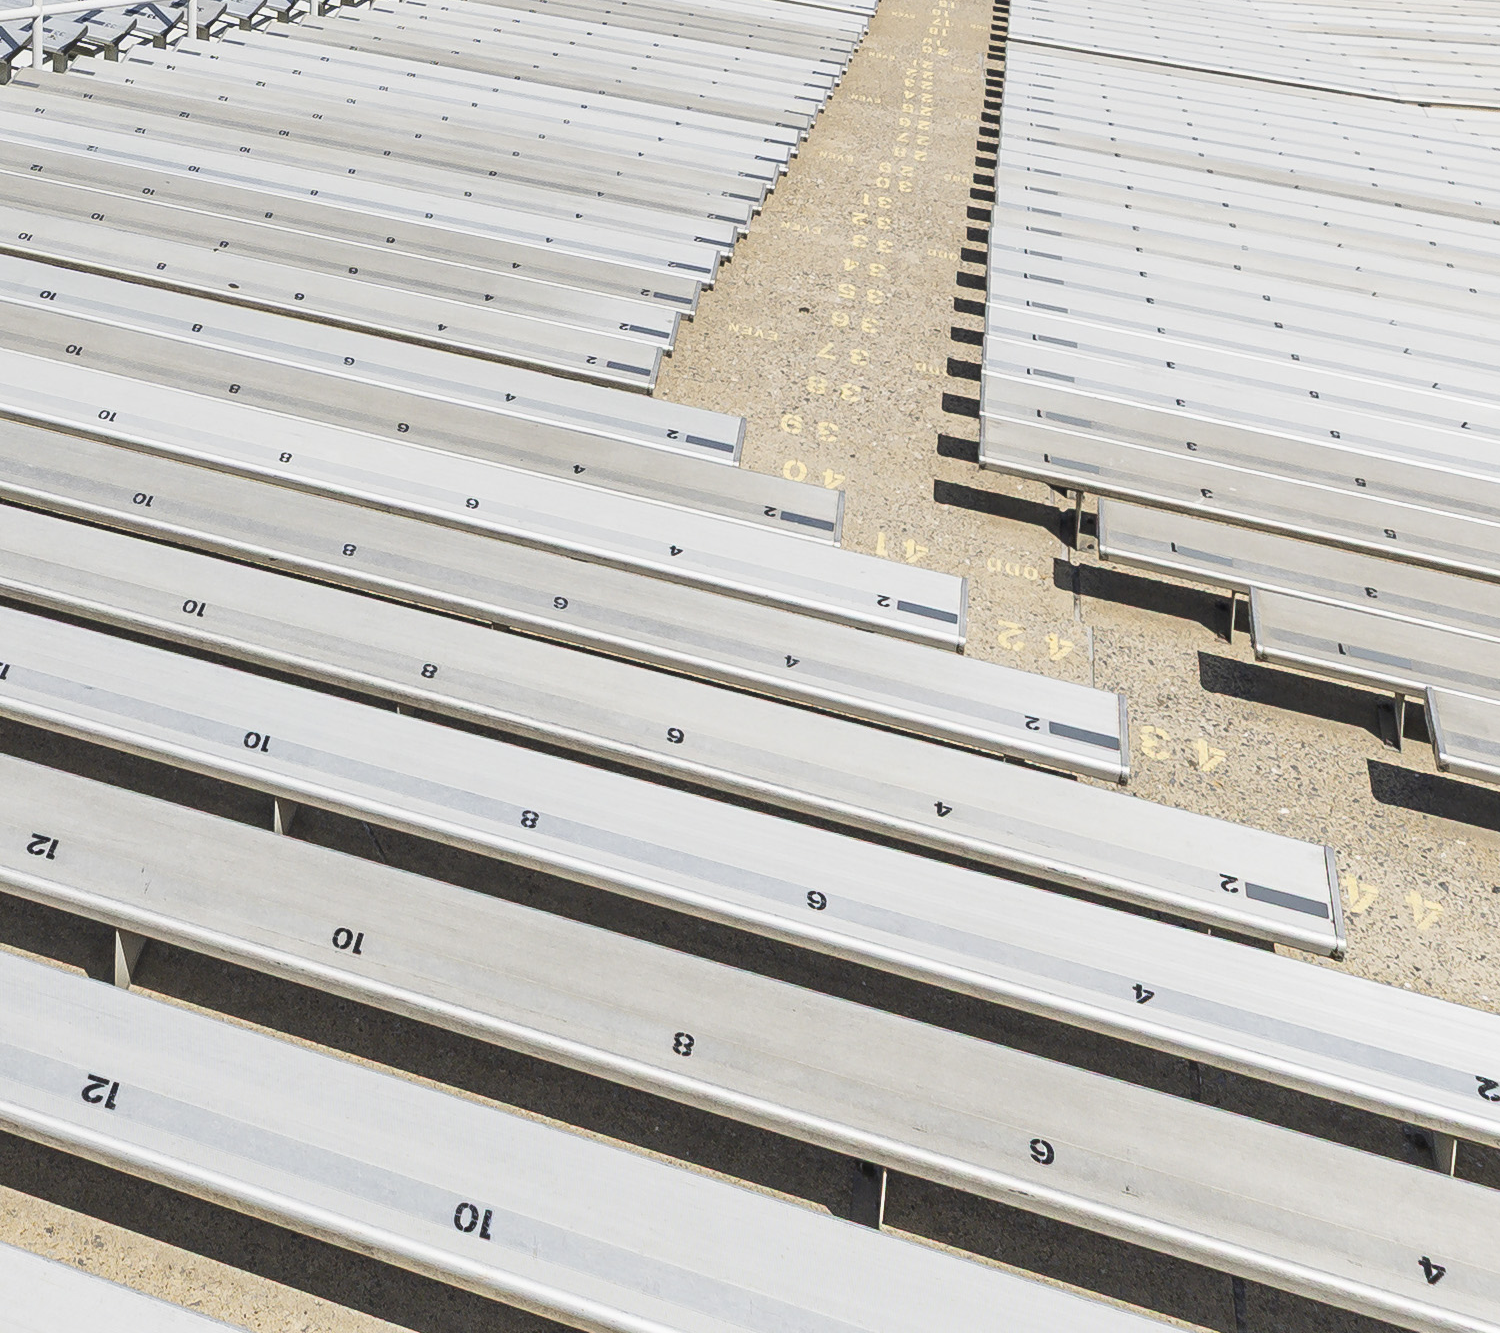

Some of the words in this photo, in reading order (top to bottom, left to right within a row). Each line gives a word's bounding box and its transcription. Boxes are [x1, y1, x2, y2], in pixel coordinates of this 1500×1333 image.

[783, 459, 846, 491] 40
[998, 620, 1076, 663] 42
[1139, 725, 1227, 773] 43
[26, 832, 60, 861] 12
[331, 927, 365, 956] 10
[1131, 983, 1155, 1005] 4
[81, 1073, 120, 1111] 12
[453, 1202, 493, 1241] 10
[1417, 1255, 1447, 1286] 4
